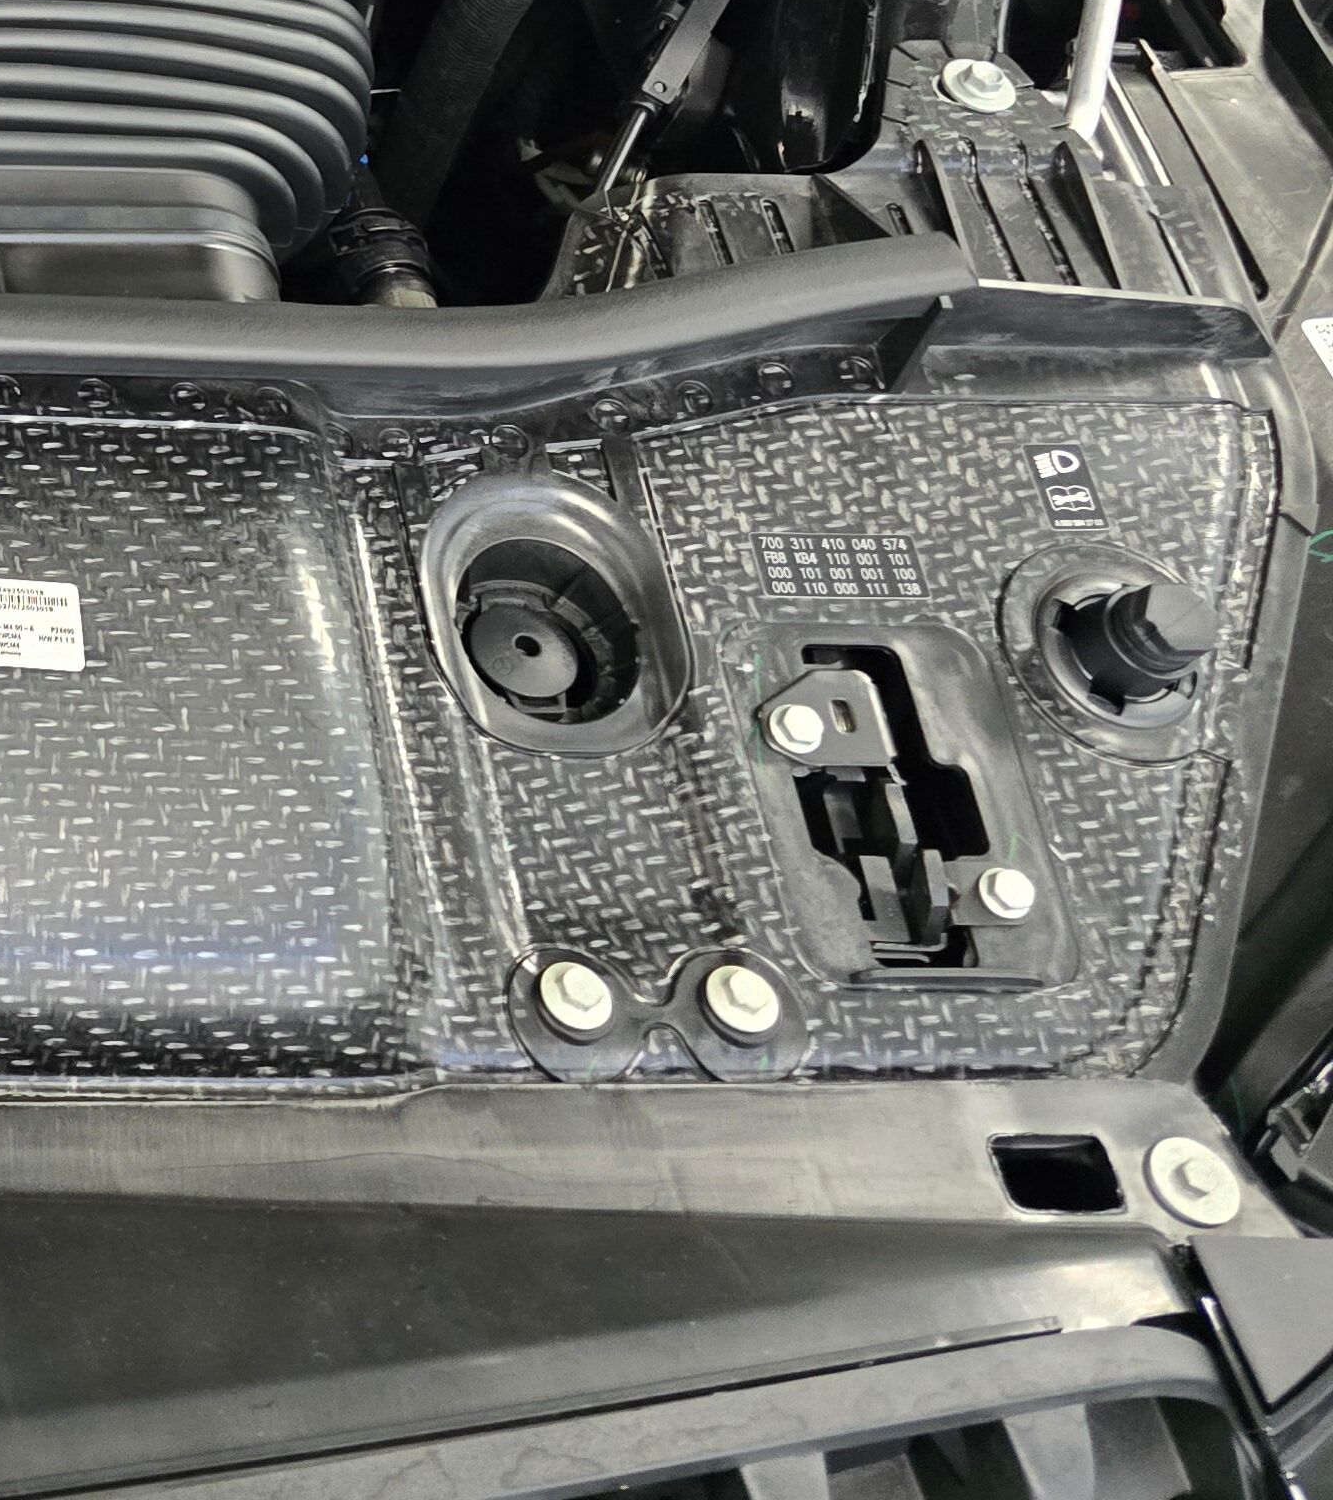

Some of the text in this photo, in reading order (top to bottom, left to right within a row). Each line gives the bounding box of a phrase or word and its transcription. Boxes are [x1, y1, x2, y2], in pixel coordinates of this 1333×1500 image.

[758, 537, 907, 550] 700 311 410 040 574
[825, 553, 850, 565] 110
[856, 553, 881, 565] 001
[768, 567, 792, 579] 000
[829, 568, 854, 579] 001
[861, 568, 885, 580] 001
[892, 569, 917, 580] 100
[771, 582, 922, 595] 000 110 000 111 138
